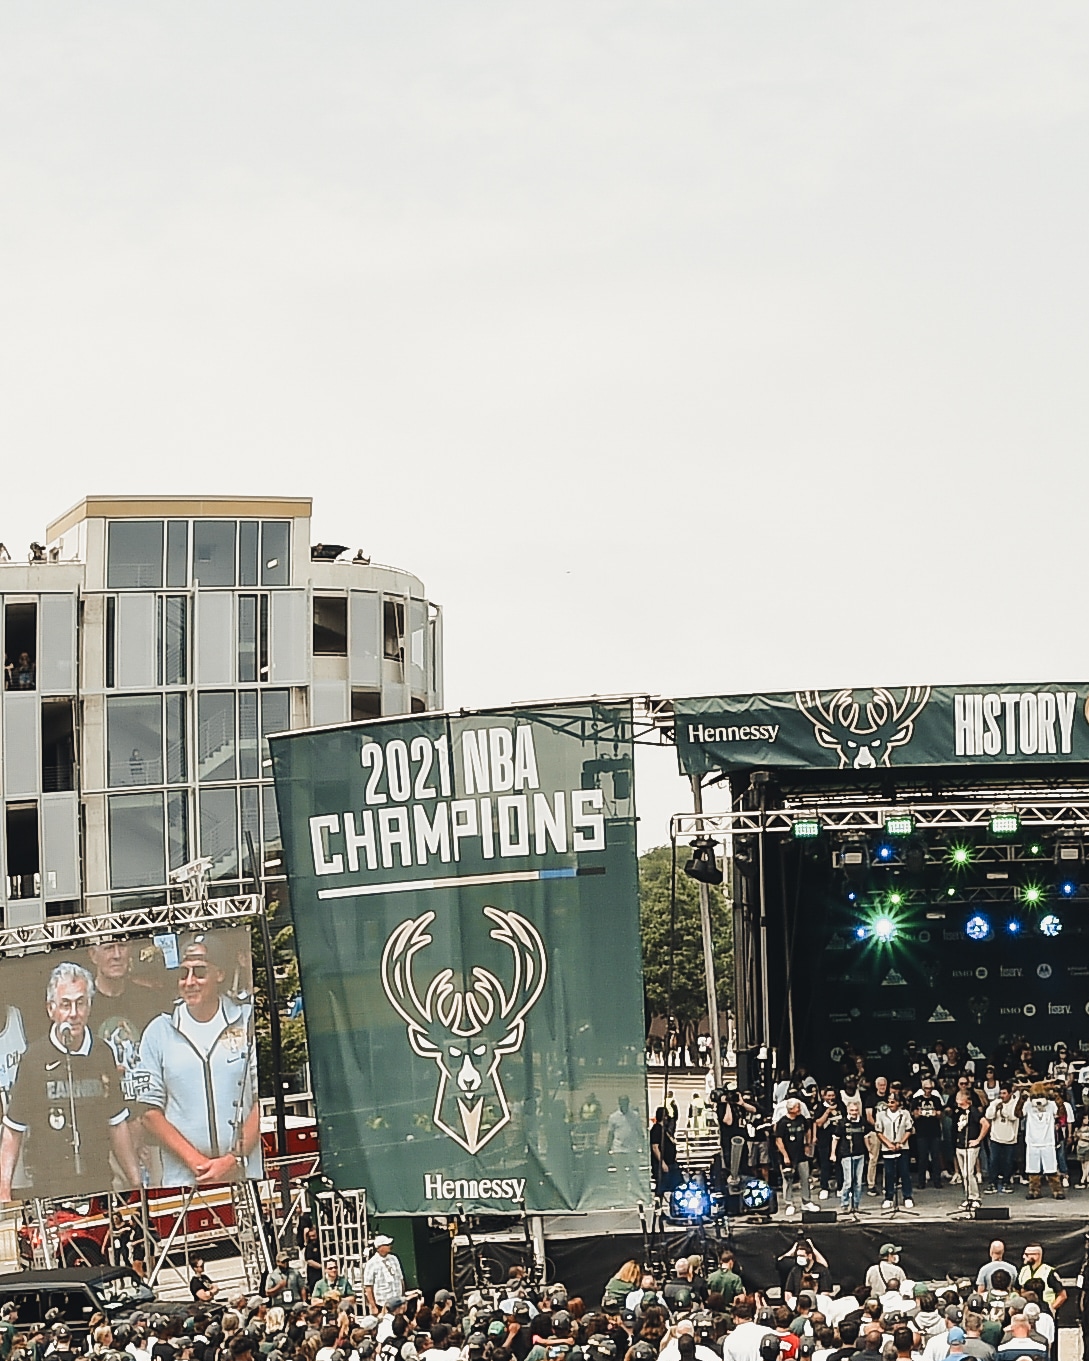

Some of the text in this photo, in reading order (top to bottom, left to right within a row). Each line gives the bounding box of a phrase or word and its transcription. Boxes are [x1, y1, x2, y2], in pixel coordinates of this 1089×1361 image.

[688, 722, 779, 744] Hennessy
[954, 690, 1079, 756] HISTORY
[361, 725, 541, 805] 2021 NBA
[309, 789, 606, 876] CHAMPIONS
[424, 1172, 527, 1204] Hennessy
